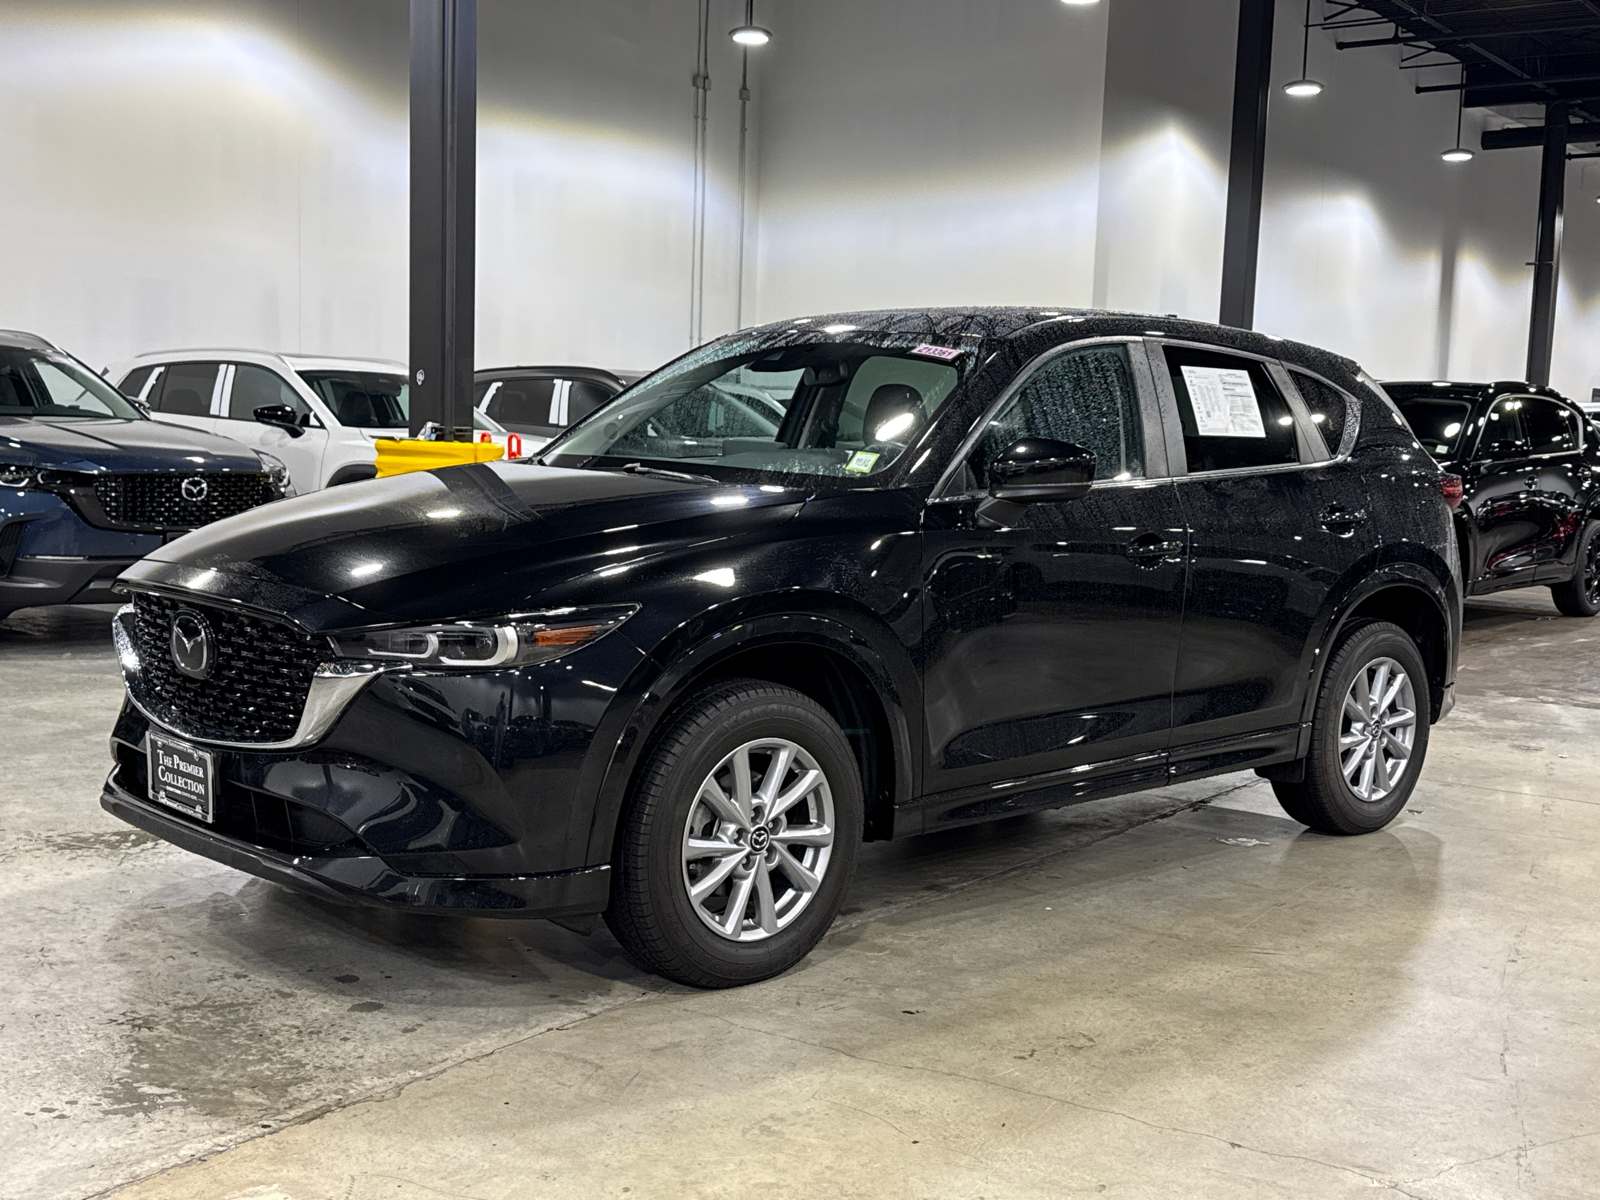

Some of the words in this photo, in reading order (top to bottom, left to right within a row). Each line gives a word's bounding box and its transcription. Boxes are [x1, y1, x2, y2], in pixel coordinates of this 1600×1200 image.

[157, 749, 173, 768] THE
[173, 754, 204, 778] PREMIER
[158, 765, 205, 796] COLLECTION
